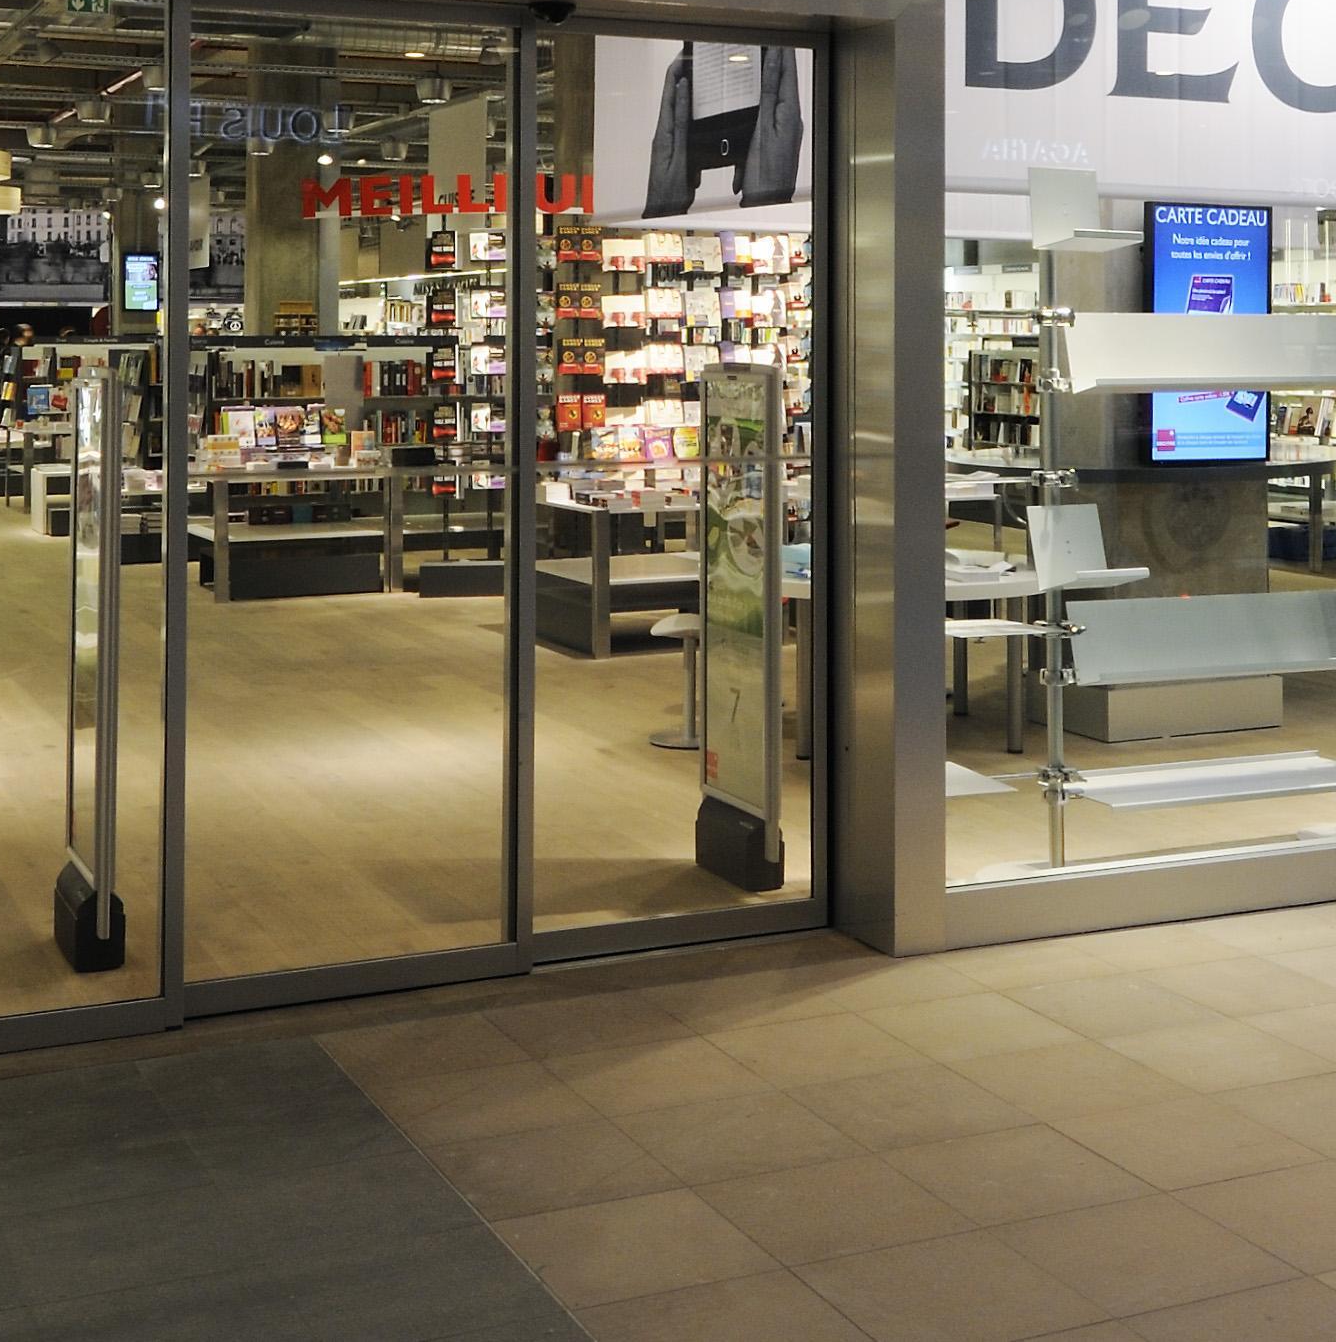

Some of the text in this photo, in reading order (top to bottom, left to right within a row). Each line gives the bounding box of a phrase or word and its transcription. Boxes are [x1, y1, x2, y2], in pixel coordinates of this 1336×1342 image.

[302, 173, 594, 219] MEILLU
[1155, 207, 1267, 226] CARTE CADEAU
